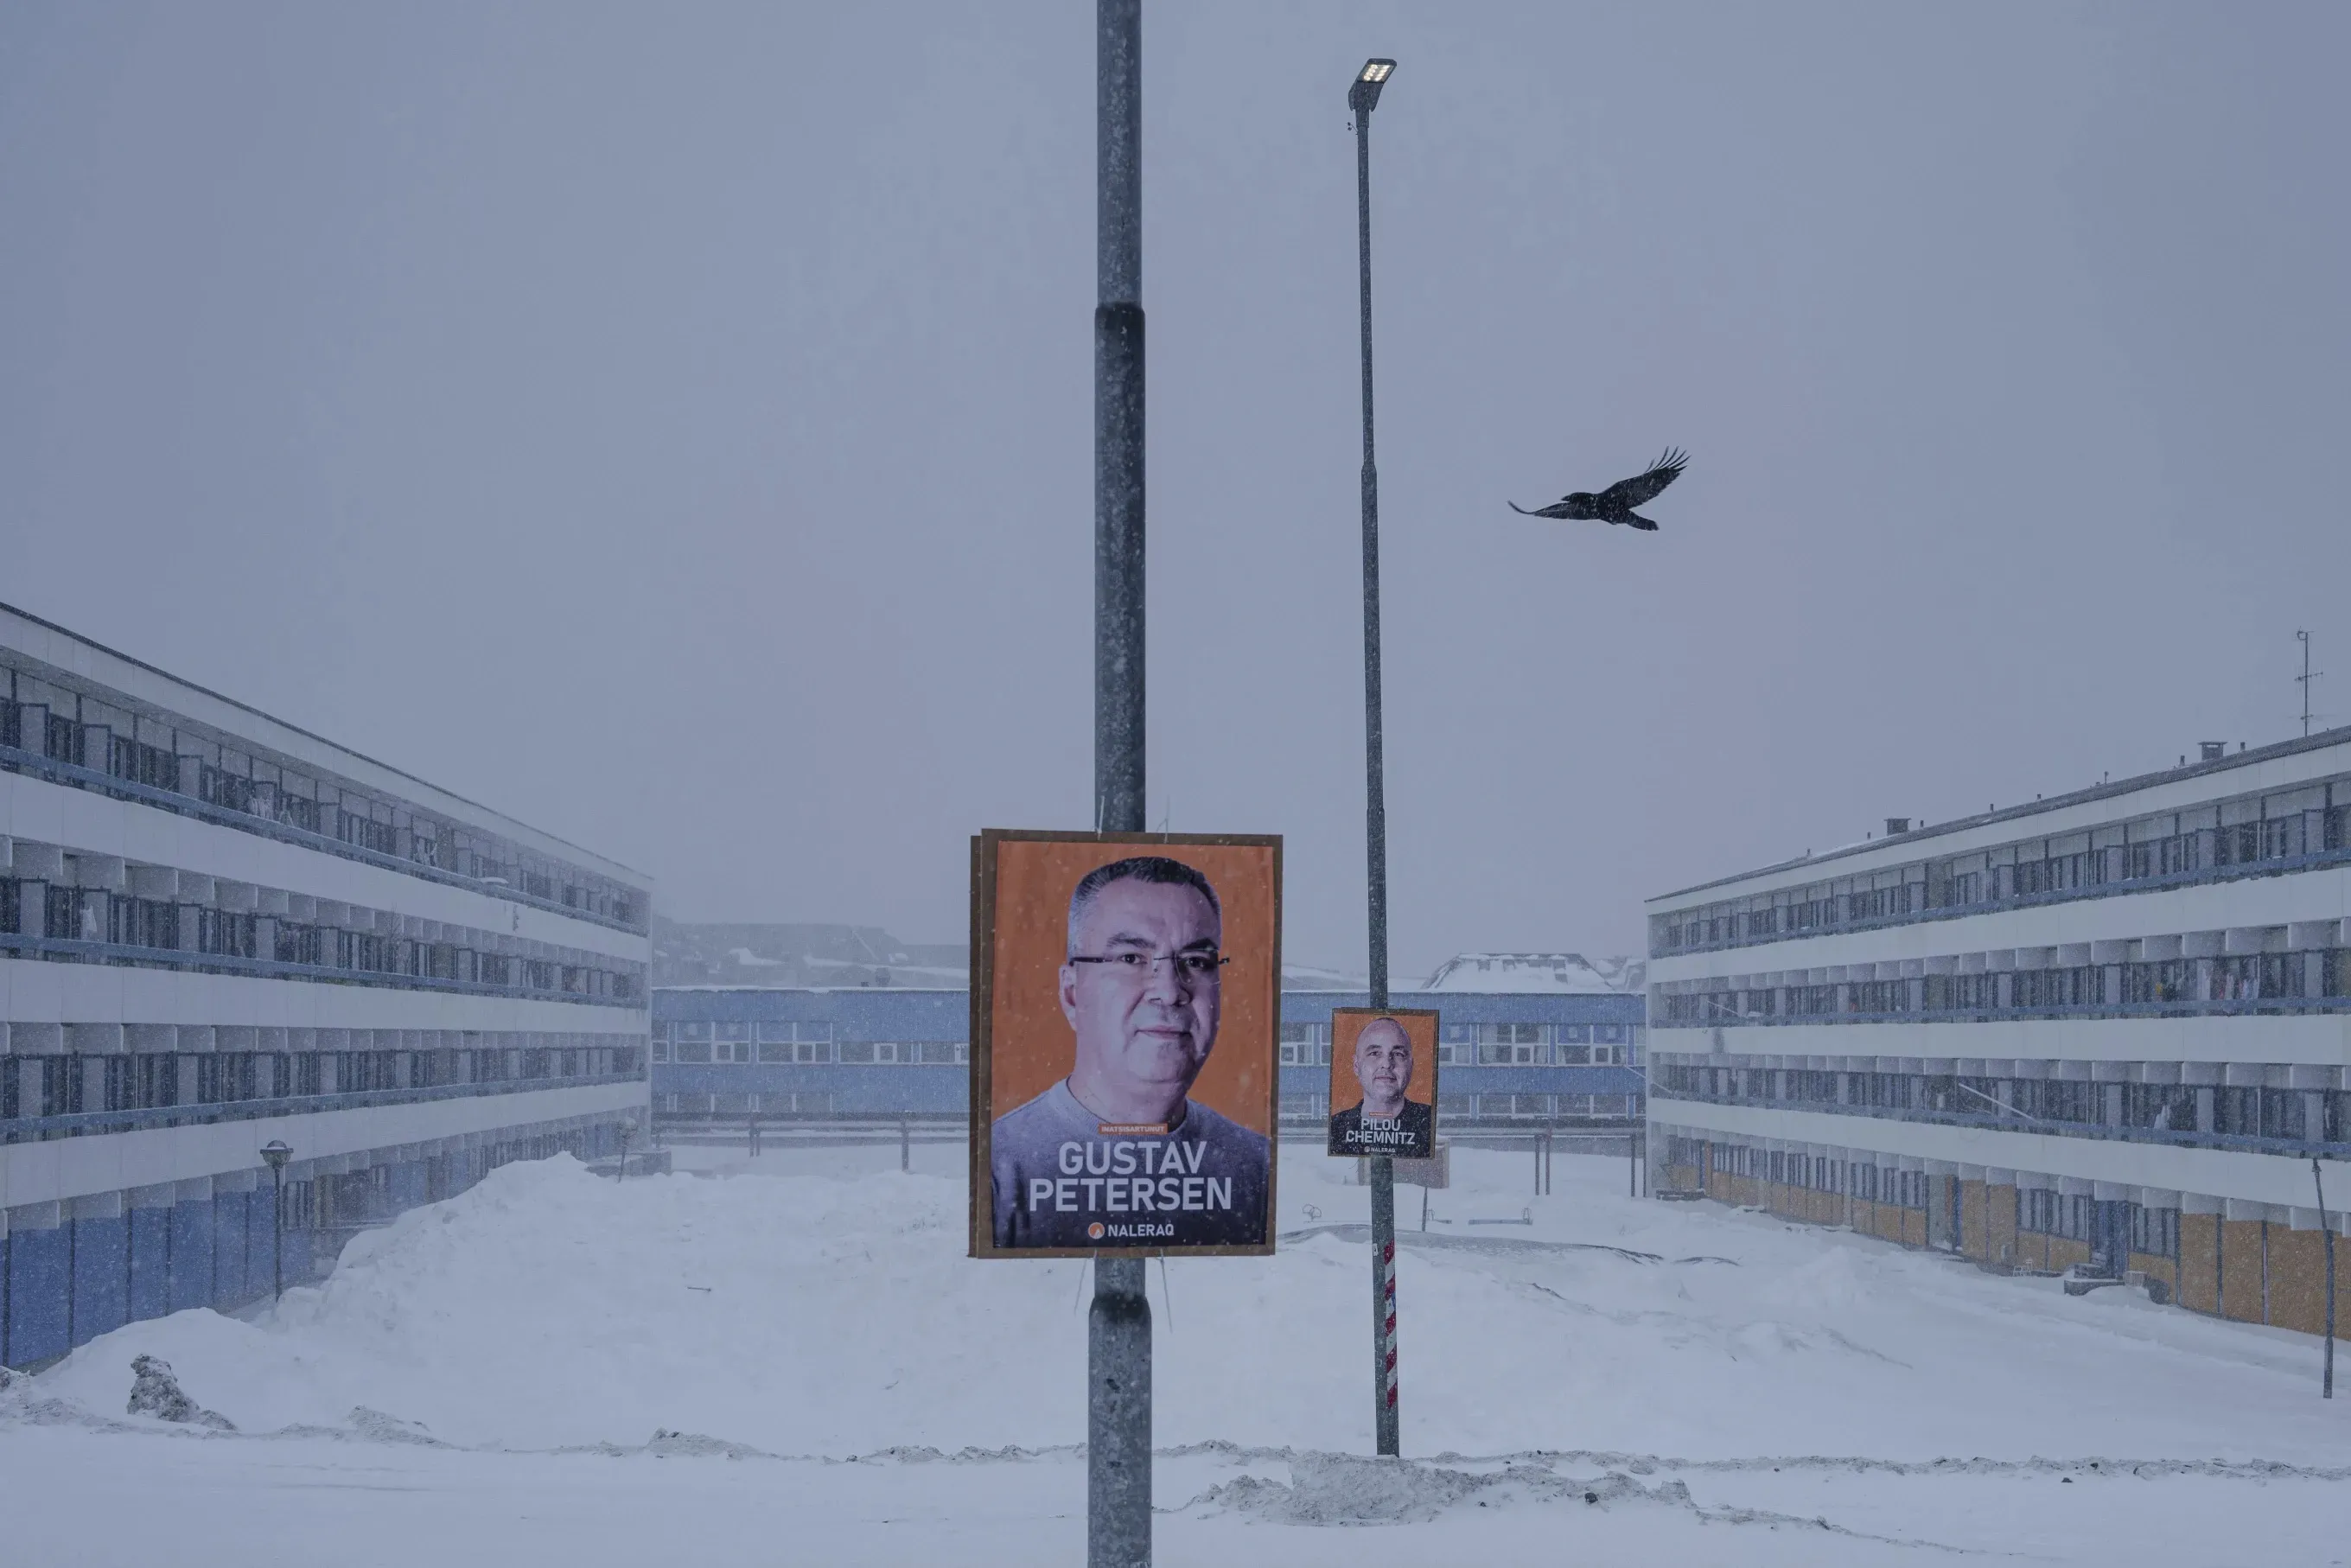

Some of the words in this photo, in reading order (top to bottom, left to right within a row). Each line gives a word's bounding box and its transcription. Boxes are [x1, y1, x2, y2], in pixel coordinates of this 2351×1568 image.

[1360, 1119, 1400, 1131] PILOU
[1346, 1131, 1415, 1144] CHEMNITZ
[1059, 1141, 1207, 1175] GUSTAV
[1029, 1176, 1232, 1211] PETERSEN
[1108, 1224, 1175, 1237] NALERAQ
